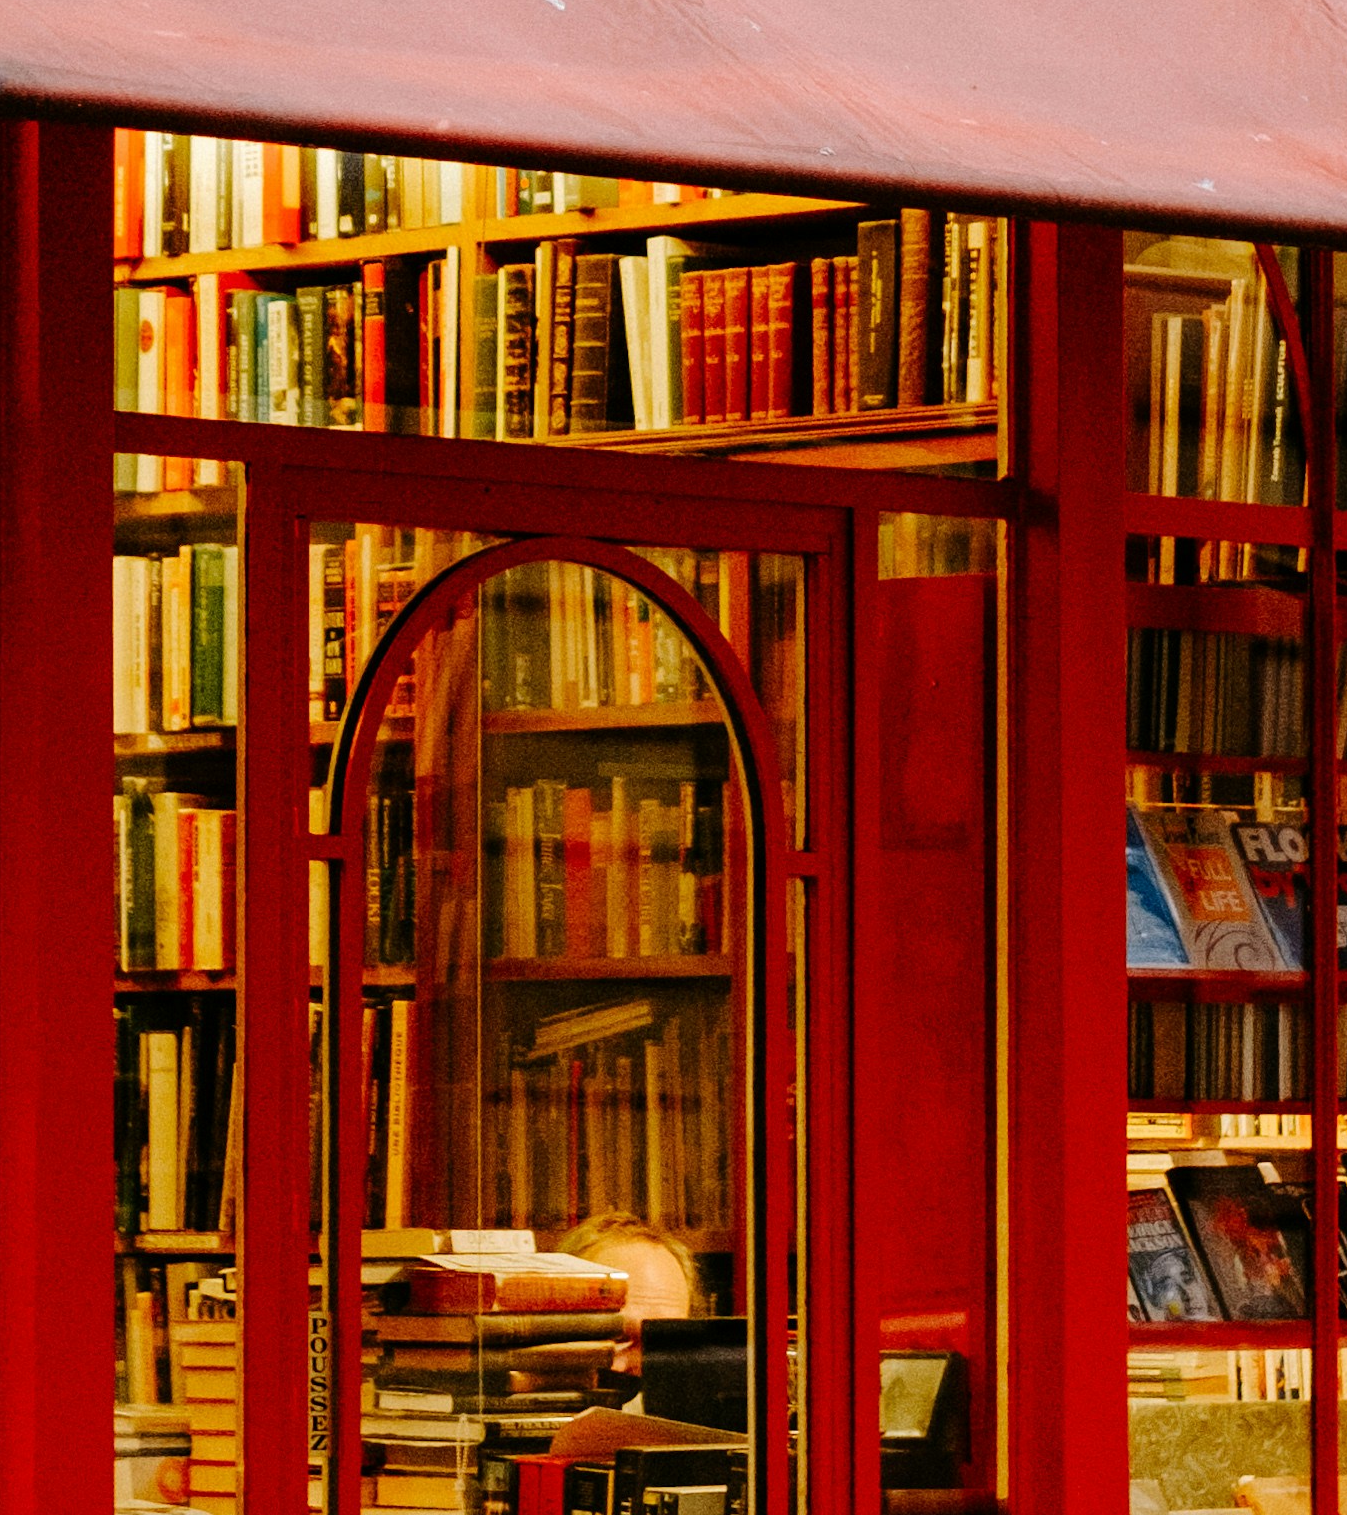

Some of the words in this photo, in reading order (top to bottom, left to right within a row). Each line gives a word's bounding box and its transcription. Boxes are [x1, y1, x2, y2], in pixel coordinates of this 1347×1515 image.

[1187, 857, 1232, 880] FULL
[1198, 890, 1245, 912] LIFE
[309, 1317, 328, 1452] POUSSEZ
